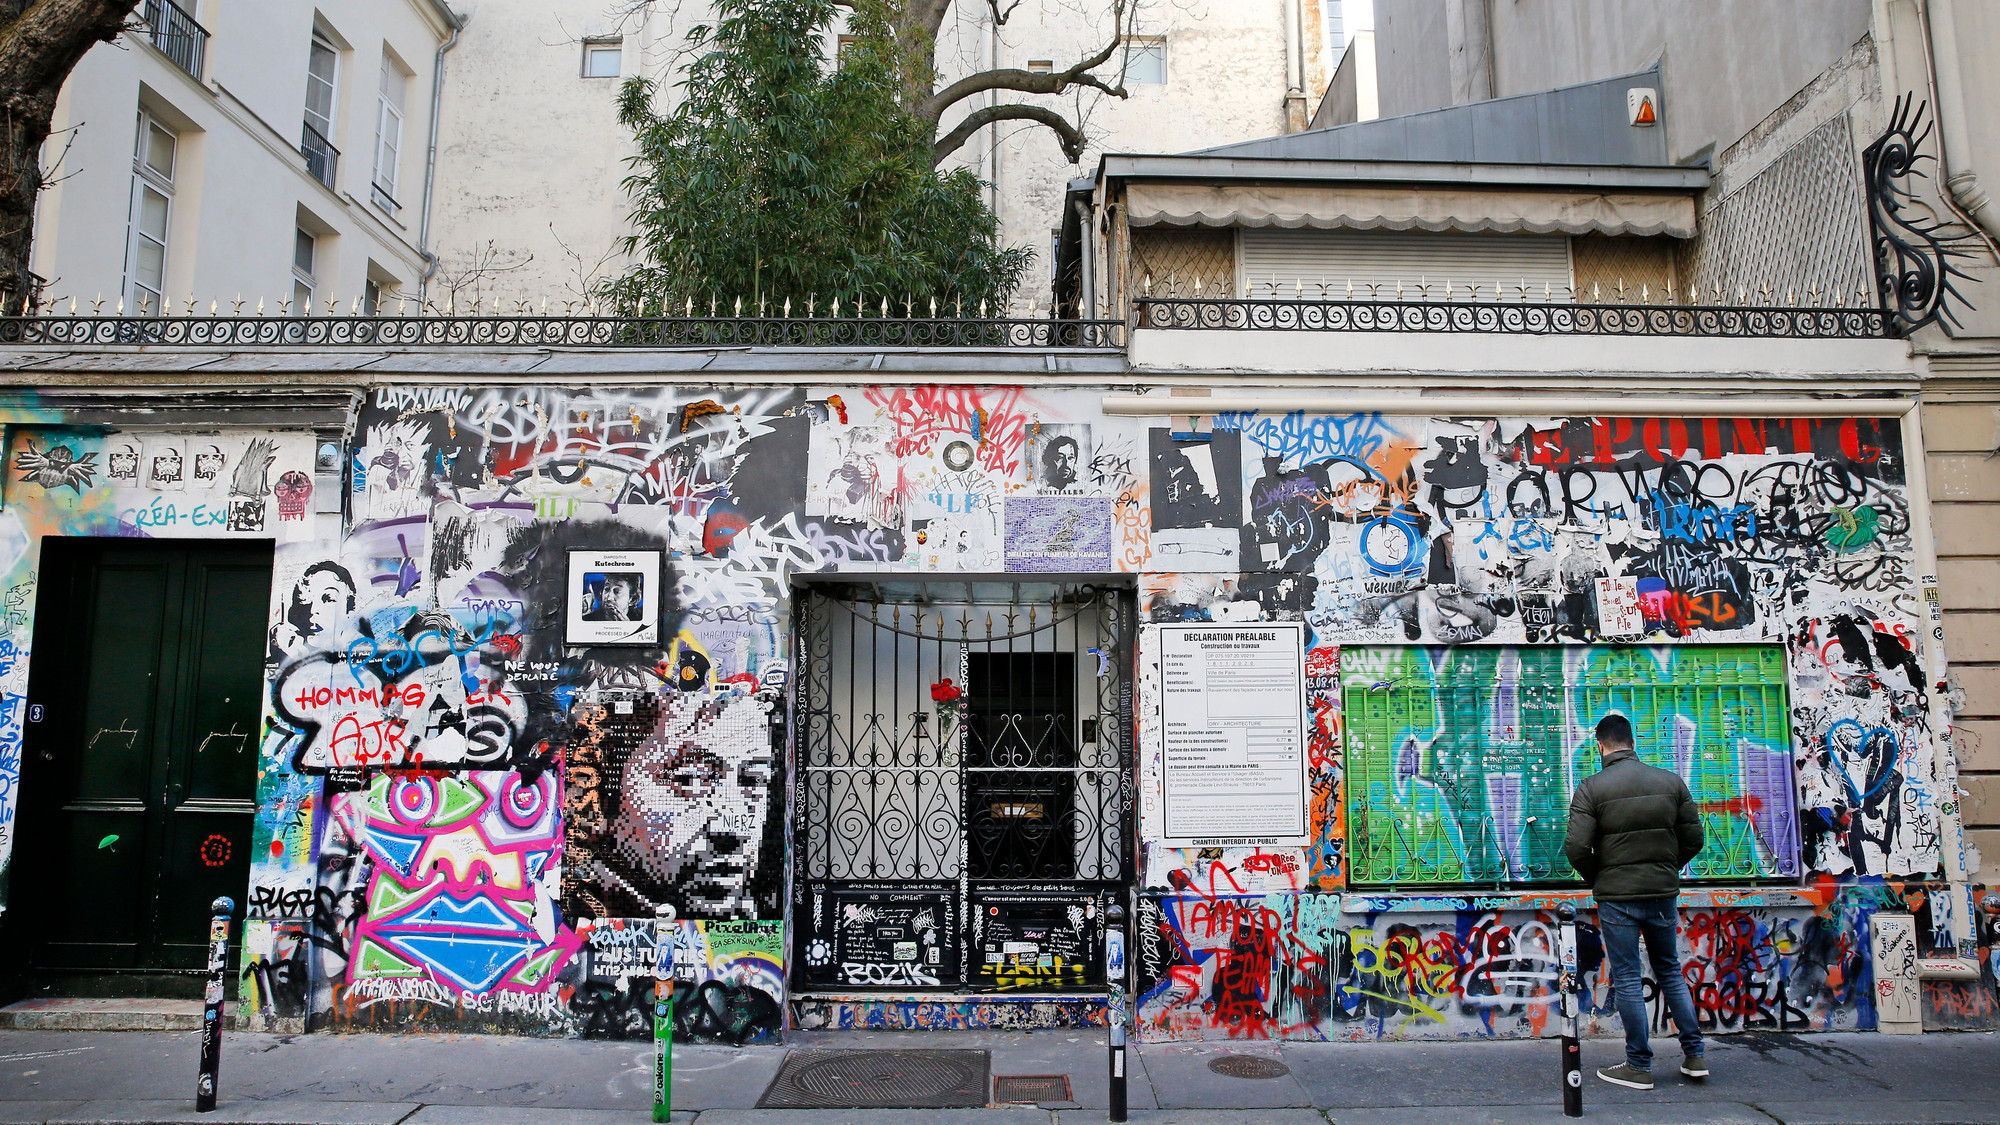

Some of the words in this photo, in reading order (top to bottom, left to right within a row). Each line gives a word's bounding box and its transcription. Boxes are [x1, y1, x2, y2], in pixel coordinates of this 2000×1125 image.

[1184, 632, 1234, 641] DÉCLARATION
[1235, 631, 1276, 641] PRÉALABLE
[33, 706, 40, 720] 3
[1257, 837, 1278, 845] PUBLIC
